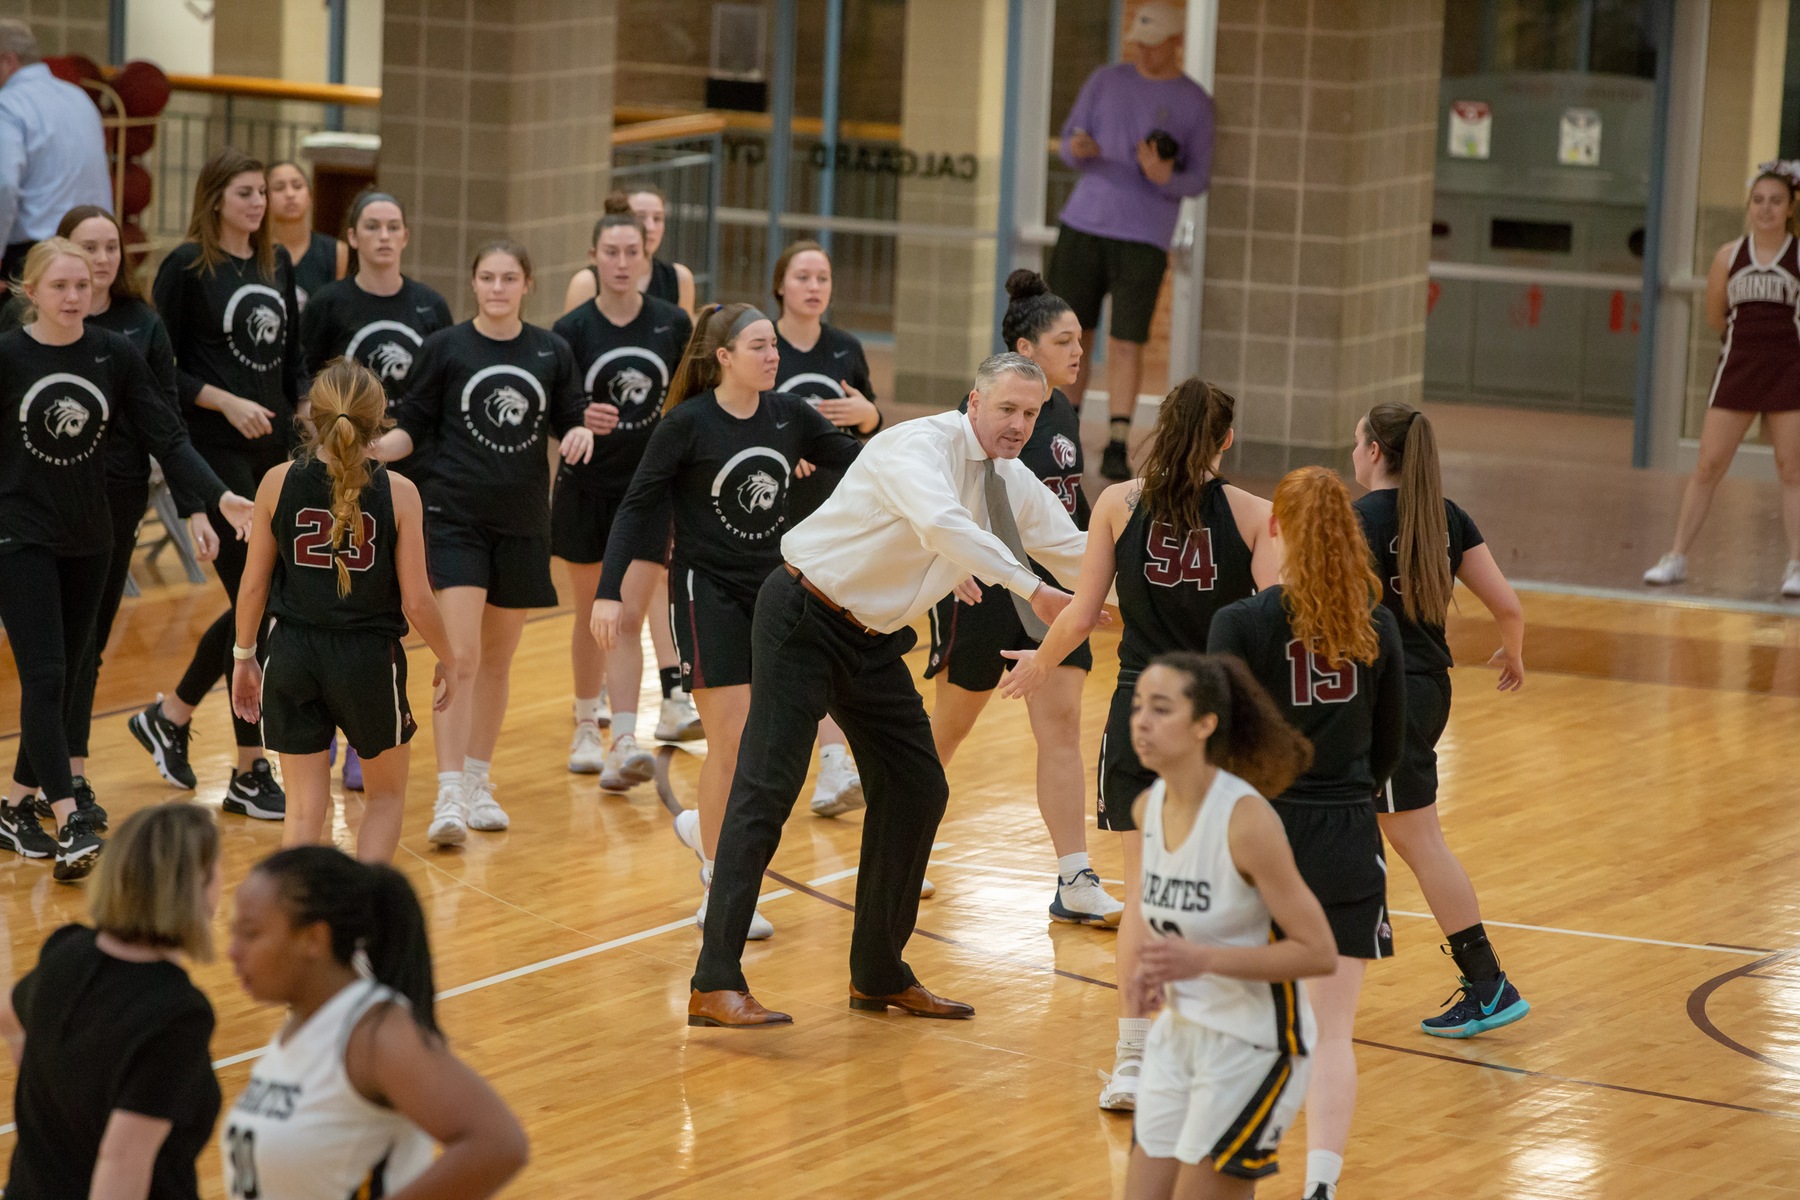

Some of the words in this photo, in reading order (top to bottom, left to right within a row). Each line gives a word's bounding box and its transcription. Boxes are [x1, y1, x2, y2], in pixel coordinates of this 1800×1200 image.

[1728, 273, 1800, 308] TRINITY
[294, 507, 376, 571] 23
[712, 499, 763, 540] TOGETHER
[1143, 519, 1218, 592] 54
[1285, 636, 1358, 706] 15
